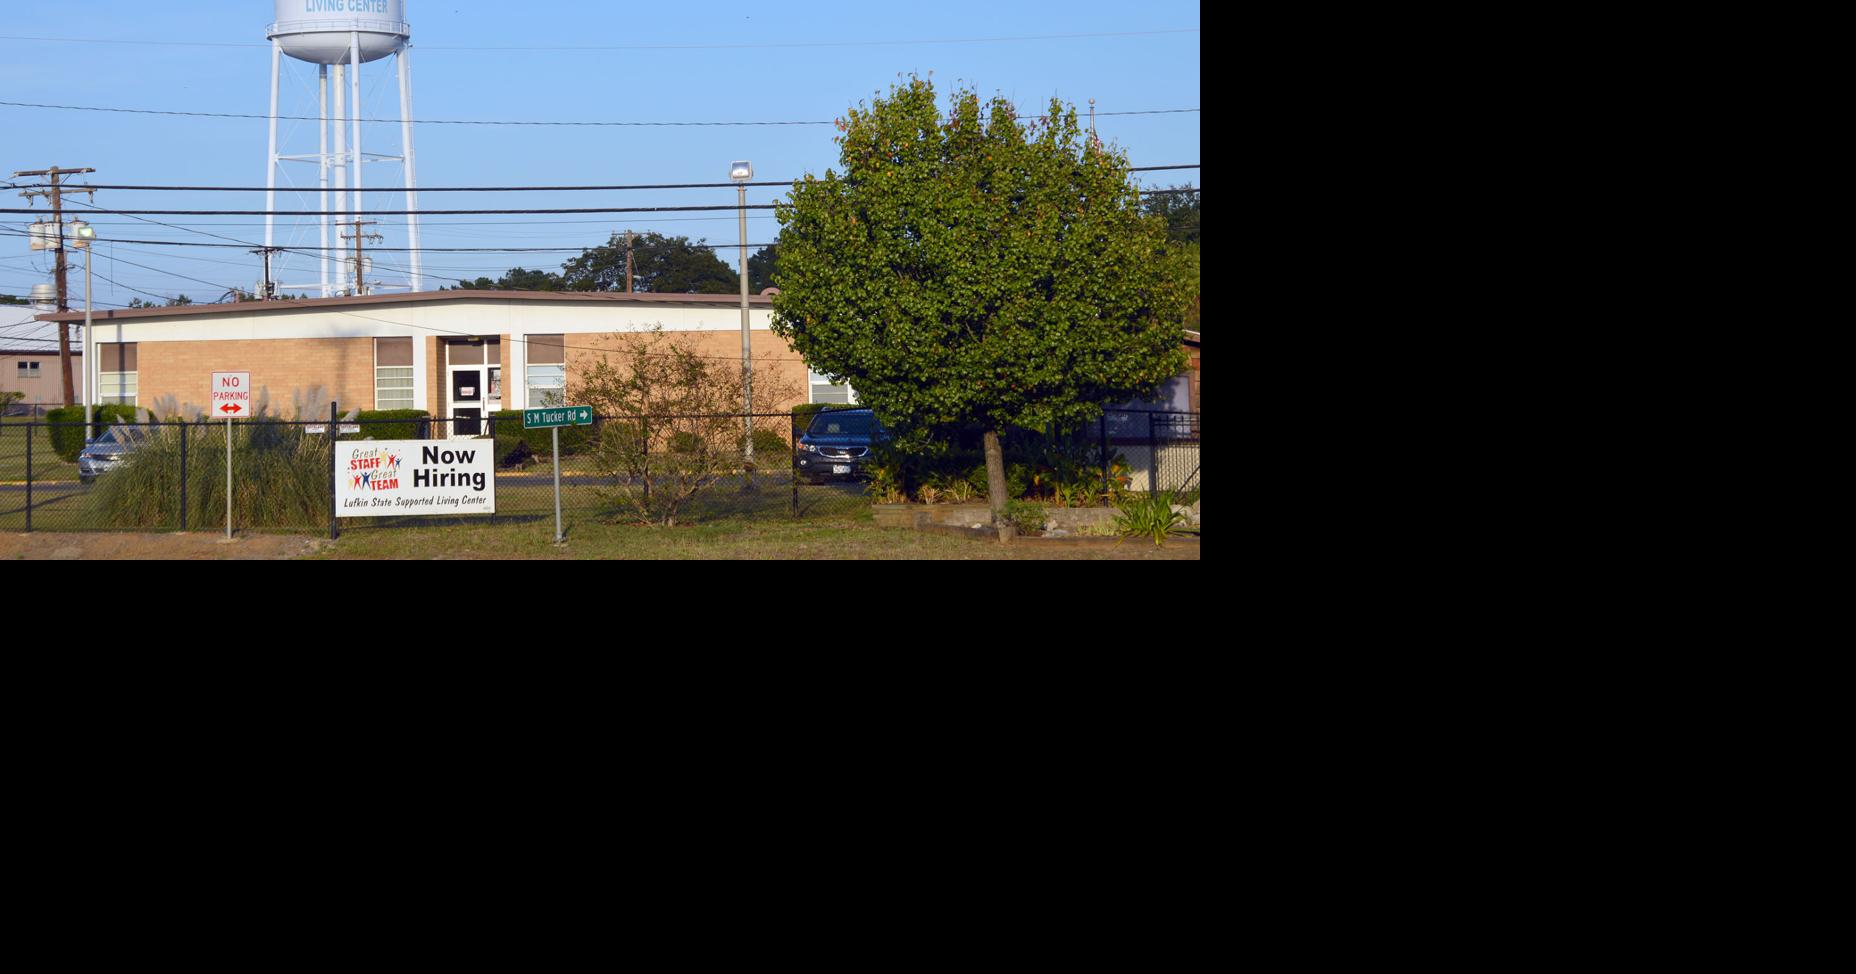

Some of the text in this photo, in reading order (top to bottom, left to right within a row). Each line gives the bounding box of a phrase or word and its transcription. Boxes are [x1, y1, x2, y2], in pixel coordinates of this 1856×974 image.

[306, 0, 388, 13] LIVING CENTER
[222, 377, 239, 387] NO
[213, 392, 248, 400] PARKING
[527, 410, 576, 424] S M Tucker Rd
[352, 448, 378, 459] Great
[422, 446, 476, 464] Now
[350, 458, 380, 470] STAFF
[371, 468, 397, 480] Great
[413, 468, 486, 491] Hiring
[370, 478, 399, 491] TEAM
[344, 495, 487, 509] Lufkin State Supported Living Center
